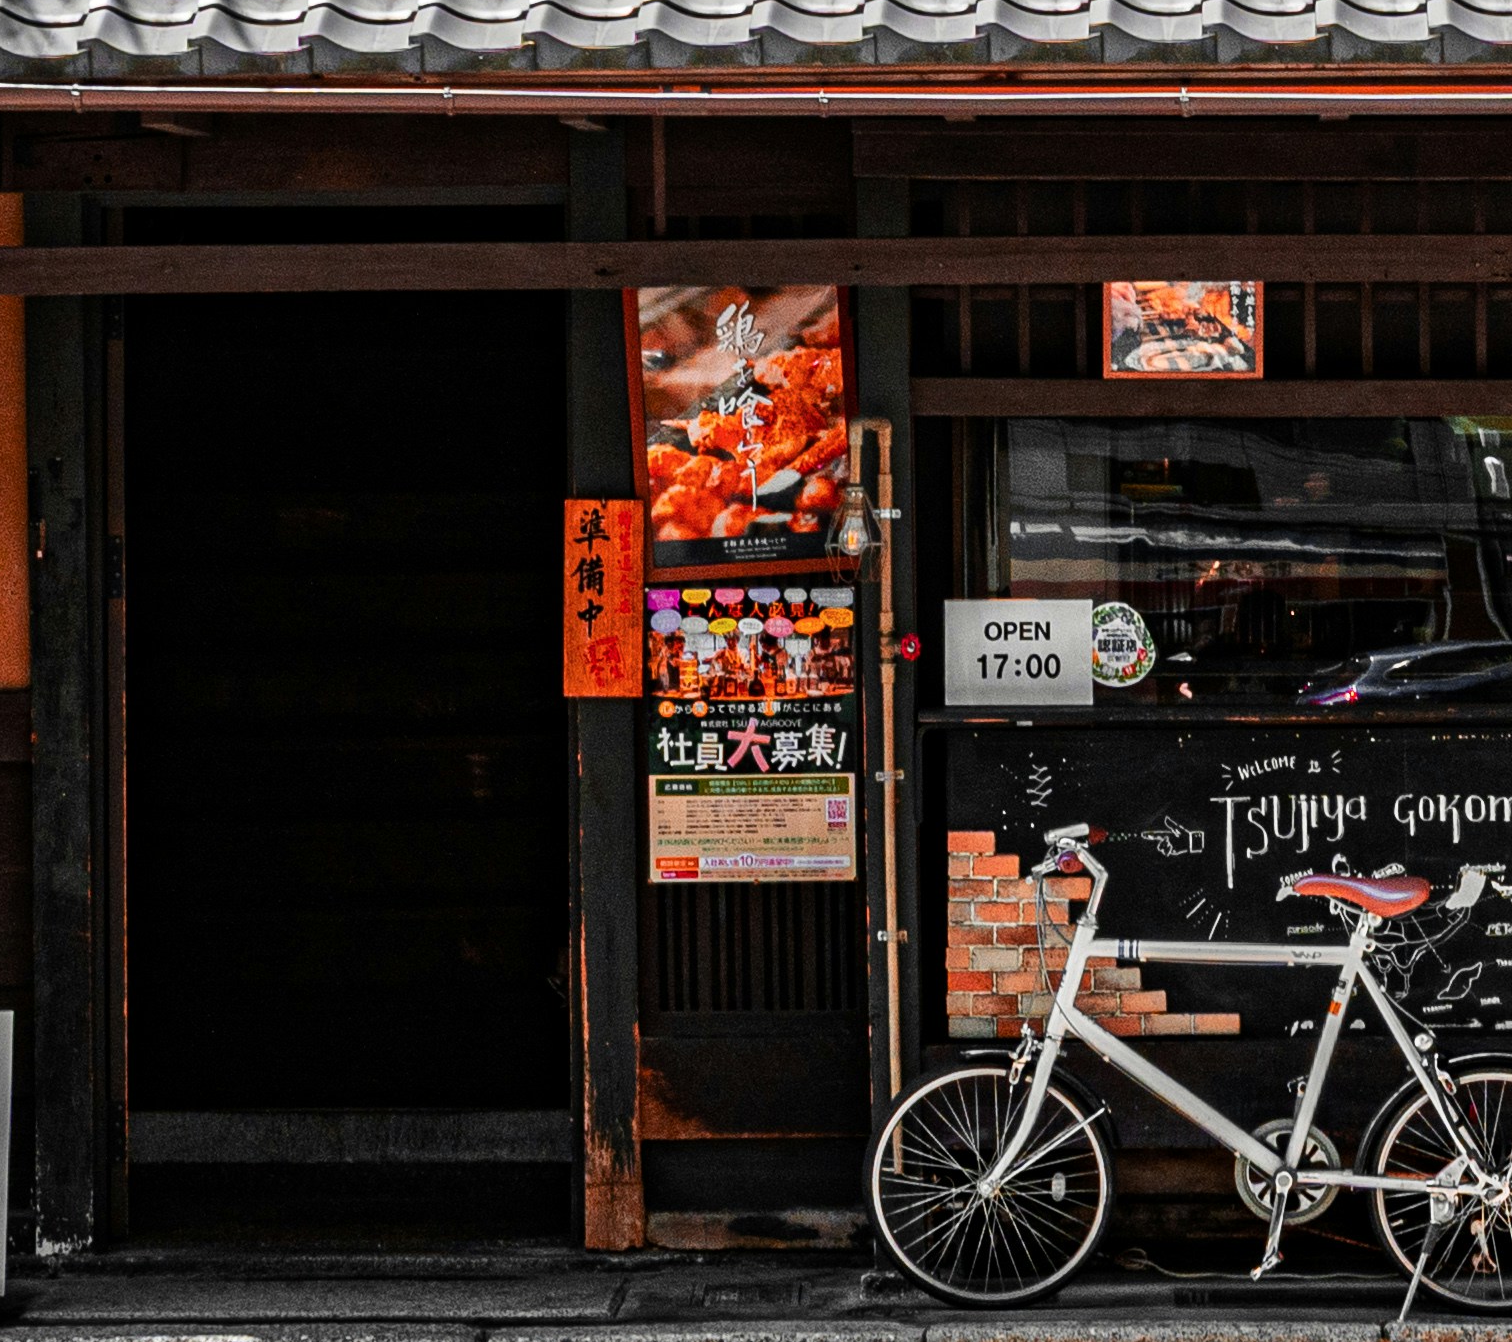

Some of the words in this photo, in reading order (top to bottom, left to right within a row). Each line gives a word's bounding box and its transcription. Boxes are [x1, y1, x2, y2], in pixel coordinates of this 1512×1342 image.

[571, 509, 611, 638] 準備中
[984, 622, 1051, 641] OPEN
[977, 654, 1061, 679] 17:00
[656, 717, 847, 772] 社員大募集!
